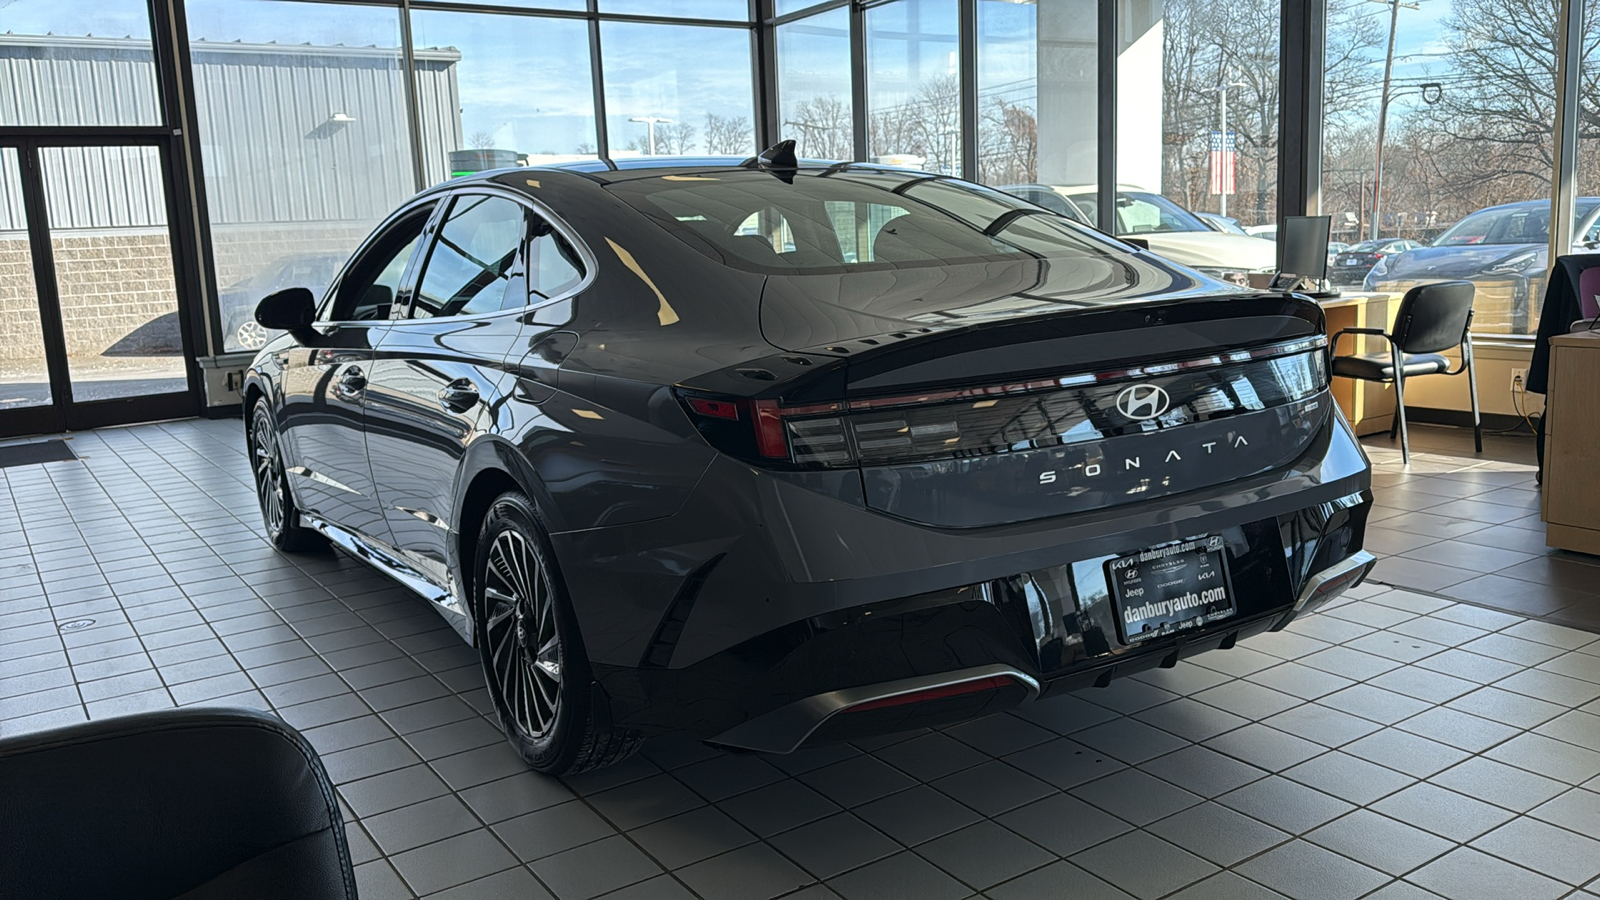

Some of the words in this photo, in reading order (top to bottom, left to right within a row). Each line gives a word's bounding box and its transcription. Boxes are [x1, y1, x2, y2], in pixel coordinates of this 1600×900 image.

[1039, 435, 1249, 485] SONATA
[1140, 541, 1195, 562] danburyauto.com
[1125, 587, 1145, 598] Jeep
[1124, 586, 1226, 624] danburyauto.com
[1178, 620, 1193, 630] Jeep
